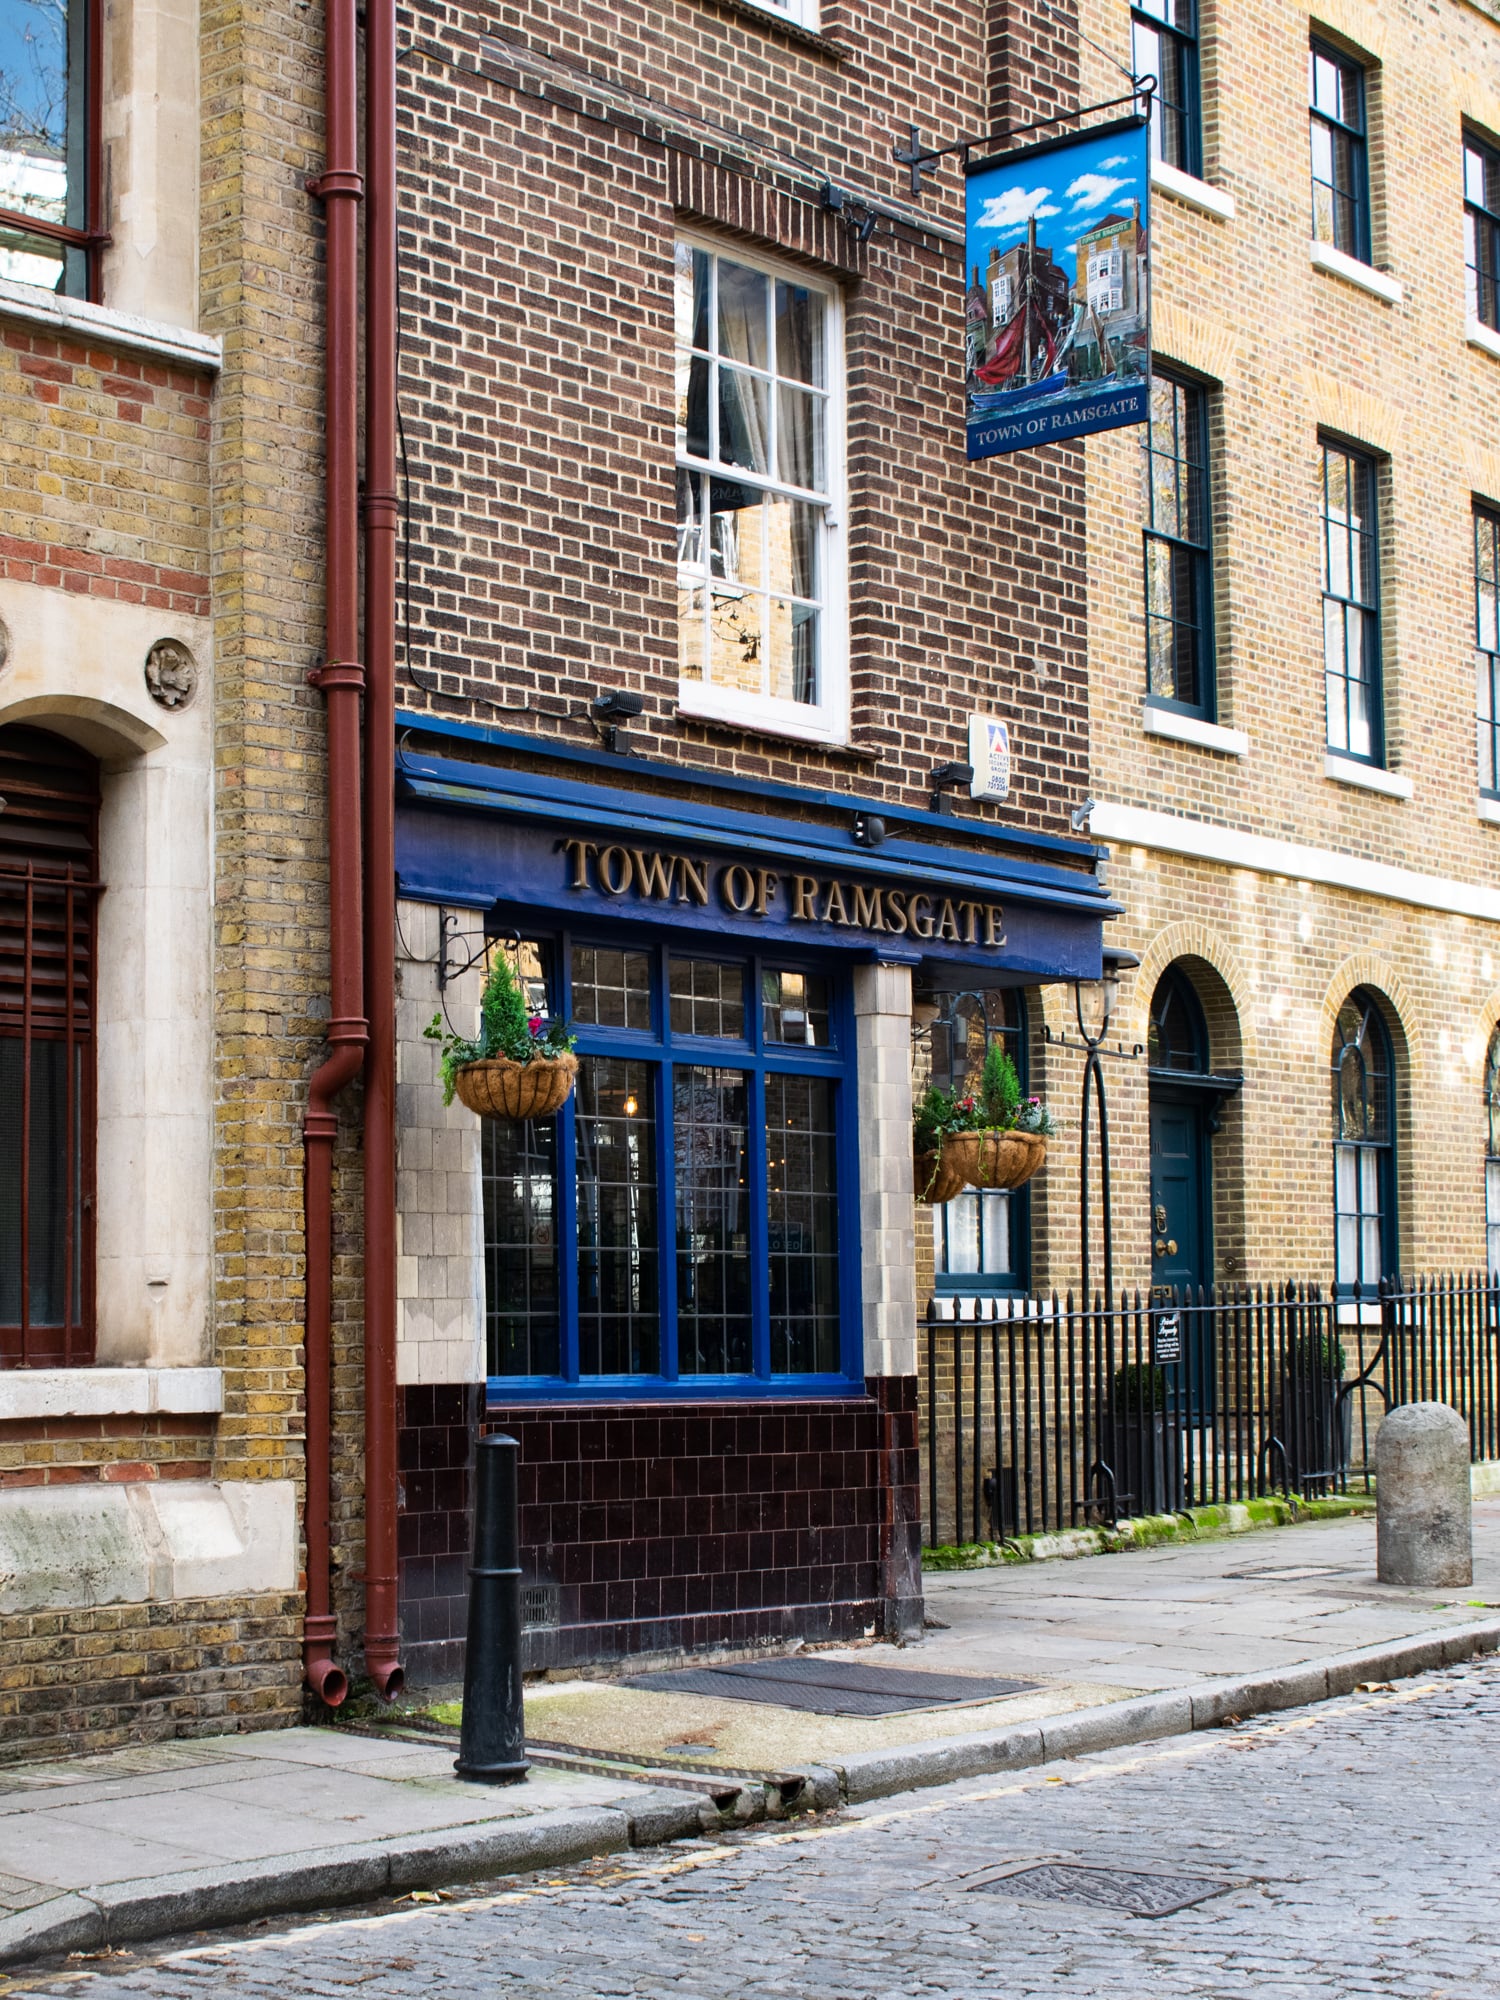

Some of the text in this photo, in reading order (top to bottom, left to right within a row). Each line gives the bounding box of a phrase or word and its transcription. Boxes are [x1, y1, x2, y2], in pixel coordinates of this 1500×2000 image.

[976, 397, 1139, 446] TOWN OF RAMSGATE
[564, 838, 1007, 947] TOWN OF RAMSGATE
